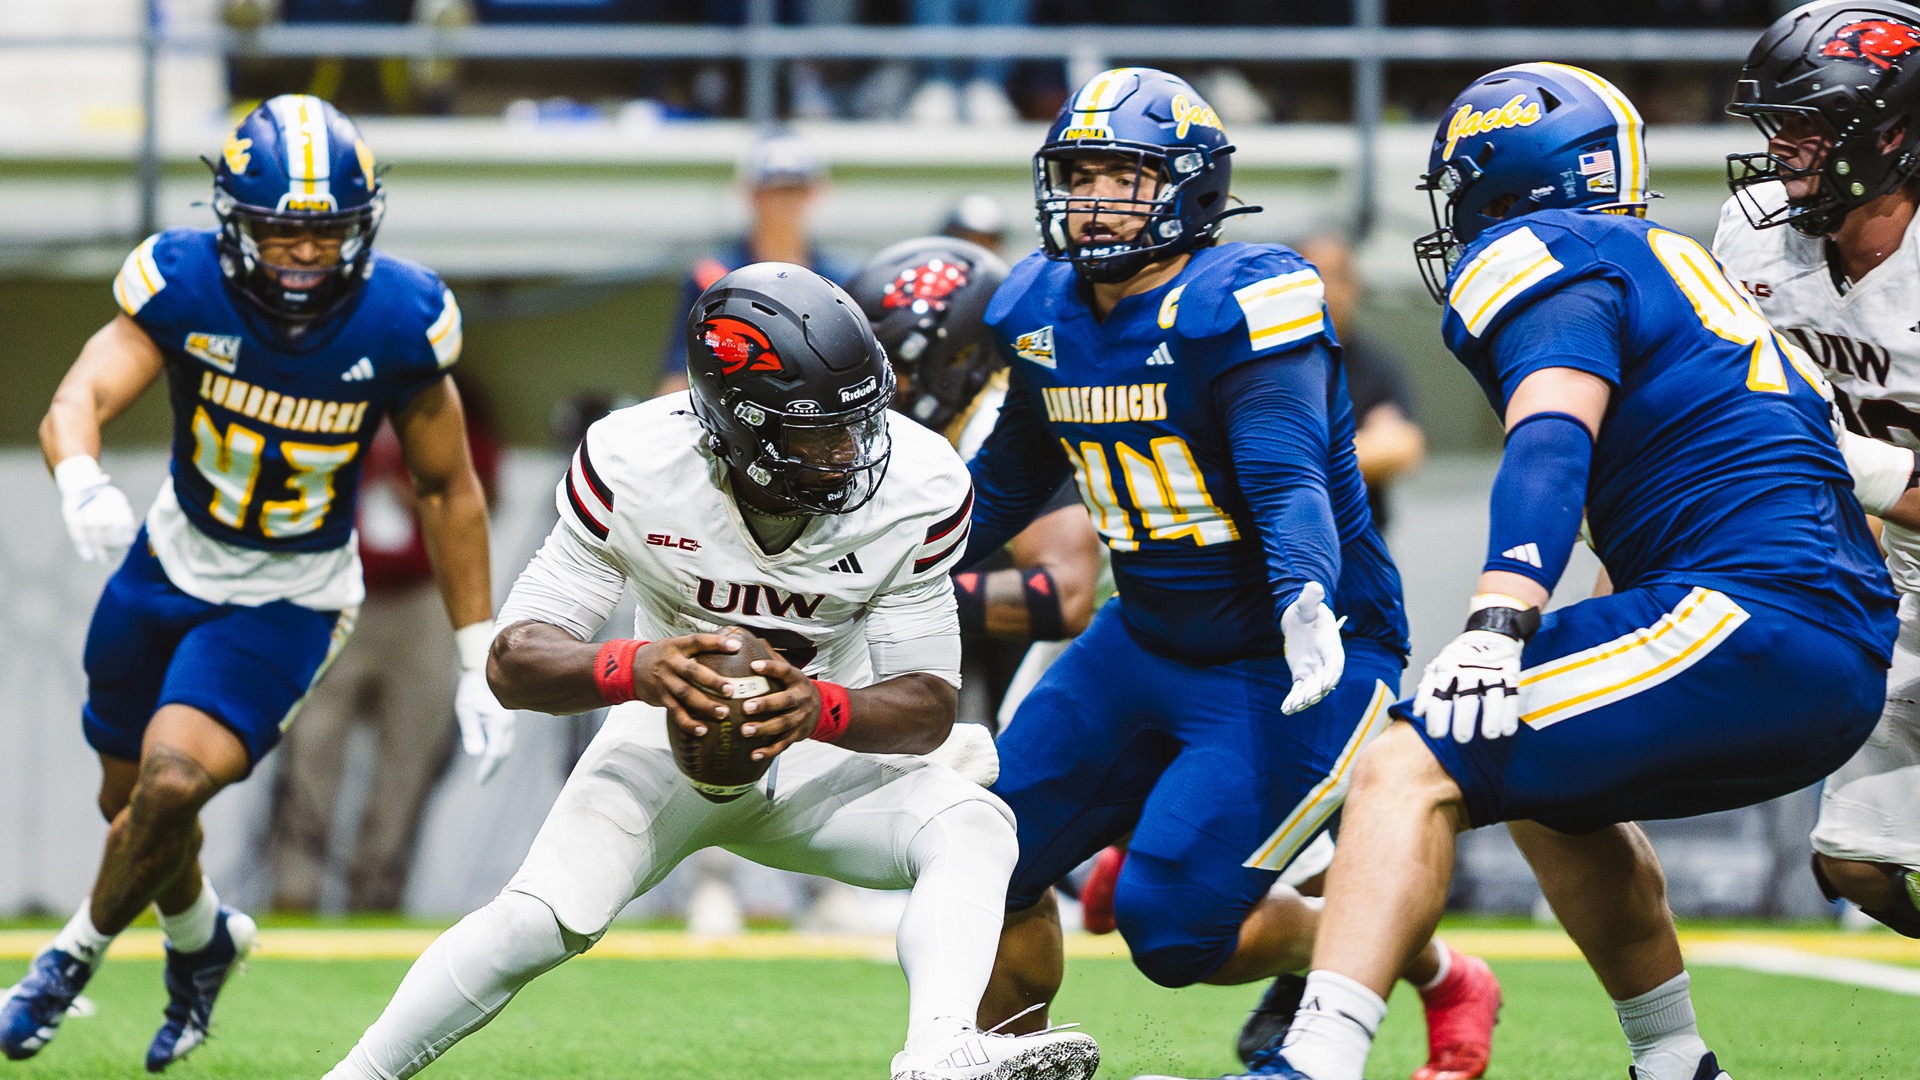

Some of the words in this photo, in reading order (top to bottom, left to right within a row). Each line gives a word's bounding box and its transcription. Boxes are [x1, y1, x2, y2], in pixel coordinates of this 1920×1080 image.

[1442, 93, 1542, 162] Jacks
[1786, 328, 1891, 388] UIW
[199, 370, 370, 434] LUMBERJACKS
[841, 379, 877, 403] Riddell
[191, 404, 360, 539] 43
[1060, 436, 1242, 552] 44
[696, 576, 826, 619] UIW
